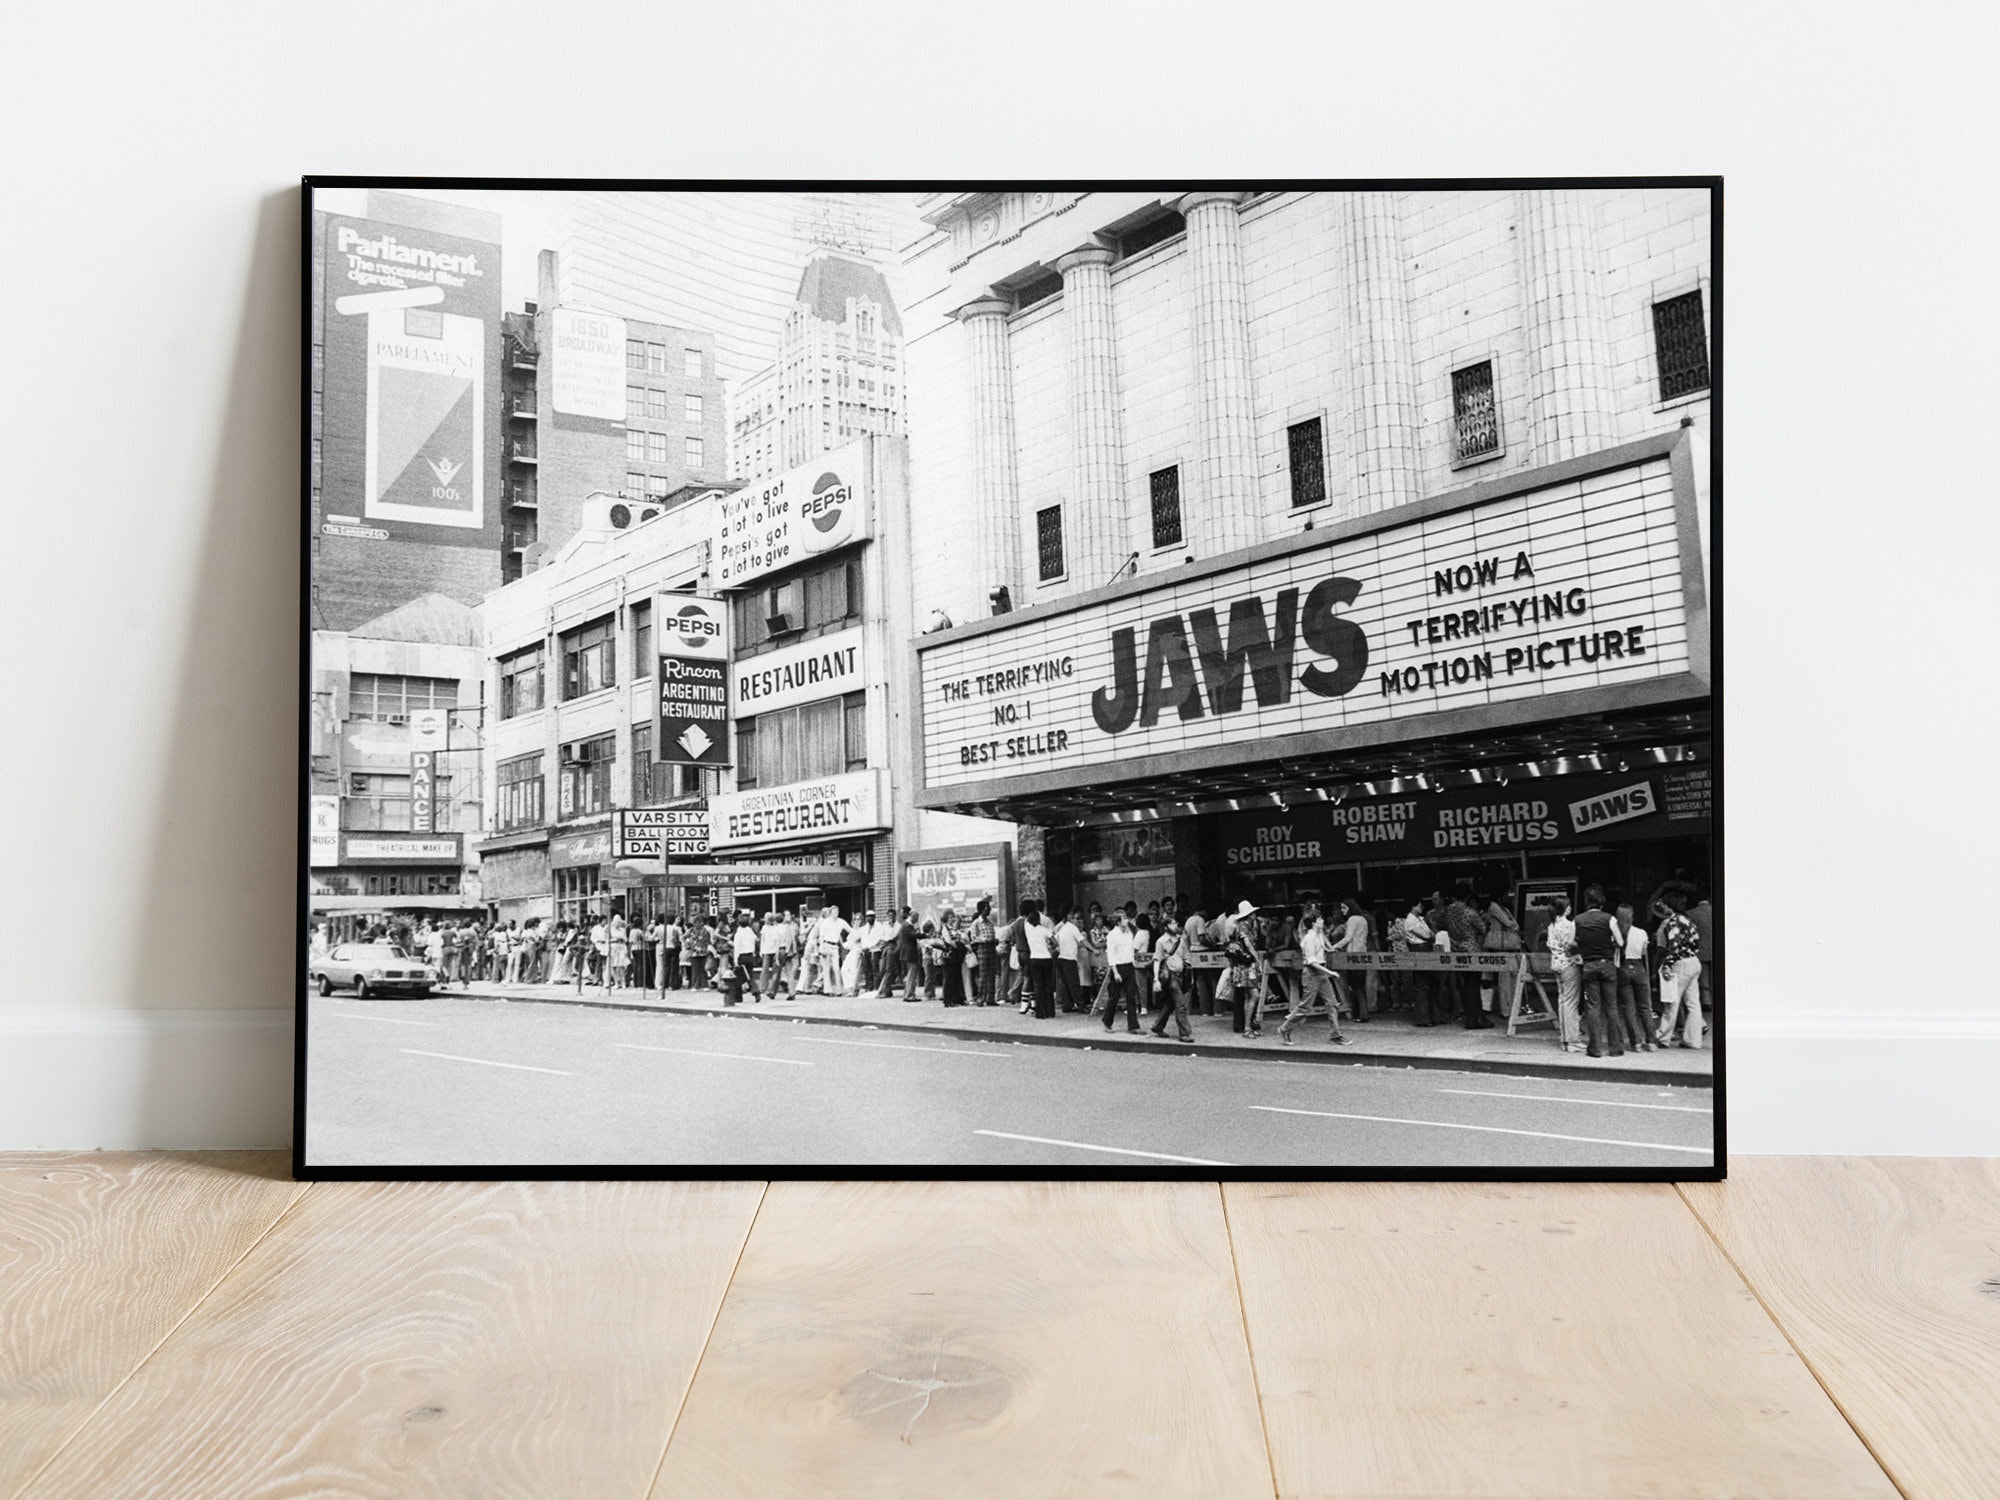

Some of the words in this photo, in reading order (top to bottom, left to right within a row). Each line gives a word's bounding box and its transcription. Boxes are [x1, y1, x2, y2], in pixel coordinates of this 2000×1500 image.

[338, 226, 484, 277] Parliament.
[346, 254, 375, 272] The
[376, 262, 434, 283] recessed
[571, 317, 609, 339] 1650
[377, 342, 474, 369] PARLIAMENT
[558, 336, 620, 356] BROADWAY
[721, 495, 757, 518] You've
[763, 480, 784, 505] got
[801, 485, 852, 518] PEPSI
[721, 527, 728, 538] a
[732, 516, 746, 532] lot
[752, 511, 763, 524] to
[767, 501, 789, 518] live
[721, 533, 760, 560] Pepsi's
[766, 522, 788, 547] got
[722, 567, 729, 579] a
[732, 557, 747, 575] lot
[751, 554, 762, 568] to
[765, 543, 789, 567] give
[1434, 556, 1500, 597] NOW
[1513, 551, 1535, 580] A
[666, 617, 720, 637] PEPSI
[1407, 587, 1587, 646] TERRIFYING
[664, 659, 722, 679] Rincon
[1091, 576, 1369, 734] JAWS
[1380, 652, 1494, 698] MOTION
[1505, 625, 1646, 676] PICTURE
[740, 646, 857, 702] RESTAURANT
[942, 679, 970, 703] THE
[976, 656, 1073, 696] TERRIFYING
[662, 682, 725, 702] ARGENTINO
[662, 701, 727, 721] RESTAURANT
[994, 703, 1021, 726] NO.
[961, 741, 999, 766] BEST
[1006, 729, 1068, 759] SELLER
[413, 753, 430, 831] DANCE
[741, 791, 794, 811] ARGENTINIAN
[800, 783, 837, 803] CORNER
[632, 812, 704, 823] VARSITY
[729, 798, 850, 839] RESTAURANT
[1332, 801, 1417, 826] ROBERT
[1438, 800, 1548, 828] RICHARD
[1575, 789, 1649, 828] JAWS
[627, 828, 709, 837] BALLROOM
[1256, 825, 1293, 844] ROY
[1346, 821, 1406, 844] SHAW
[1433, 820, 1559, 848] DREYFUSS
[376, 844, 419, 853] THEATRICAL
[422, 844, 441, 852] MAKE
[443, 844, 453, 853] UP
[631, 841, 706, 853] DANCING
[1227, 840, 1322, 864] SCHEIDER
[697, 874, 729, 884] RINCON
[734, 873, 781, 883] ARGENTINO
[917, 866, 957, 888] JAWS
[1346, 955, 1373, 964] POLICE
[1378, 955, 1396, 964] LINE
[1439, 955, 1451, 964] DO
[1456, 955, 1473, 964] NOT
[1478, 955, 1506, 965] CROSS
